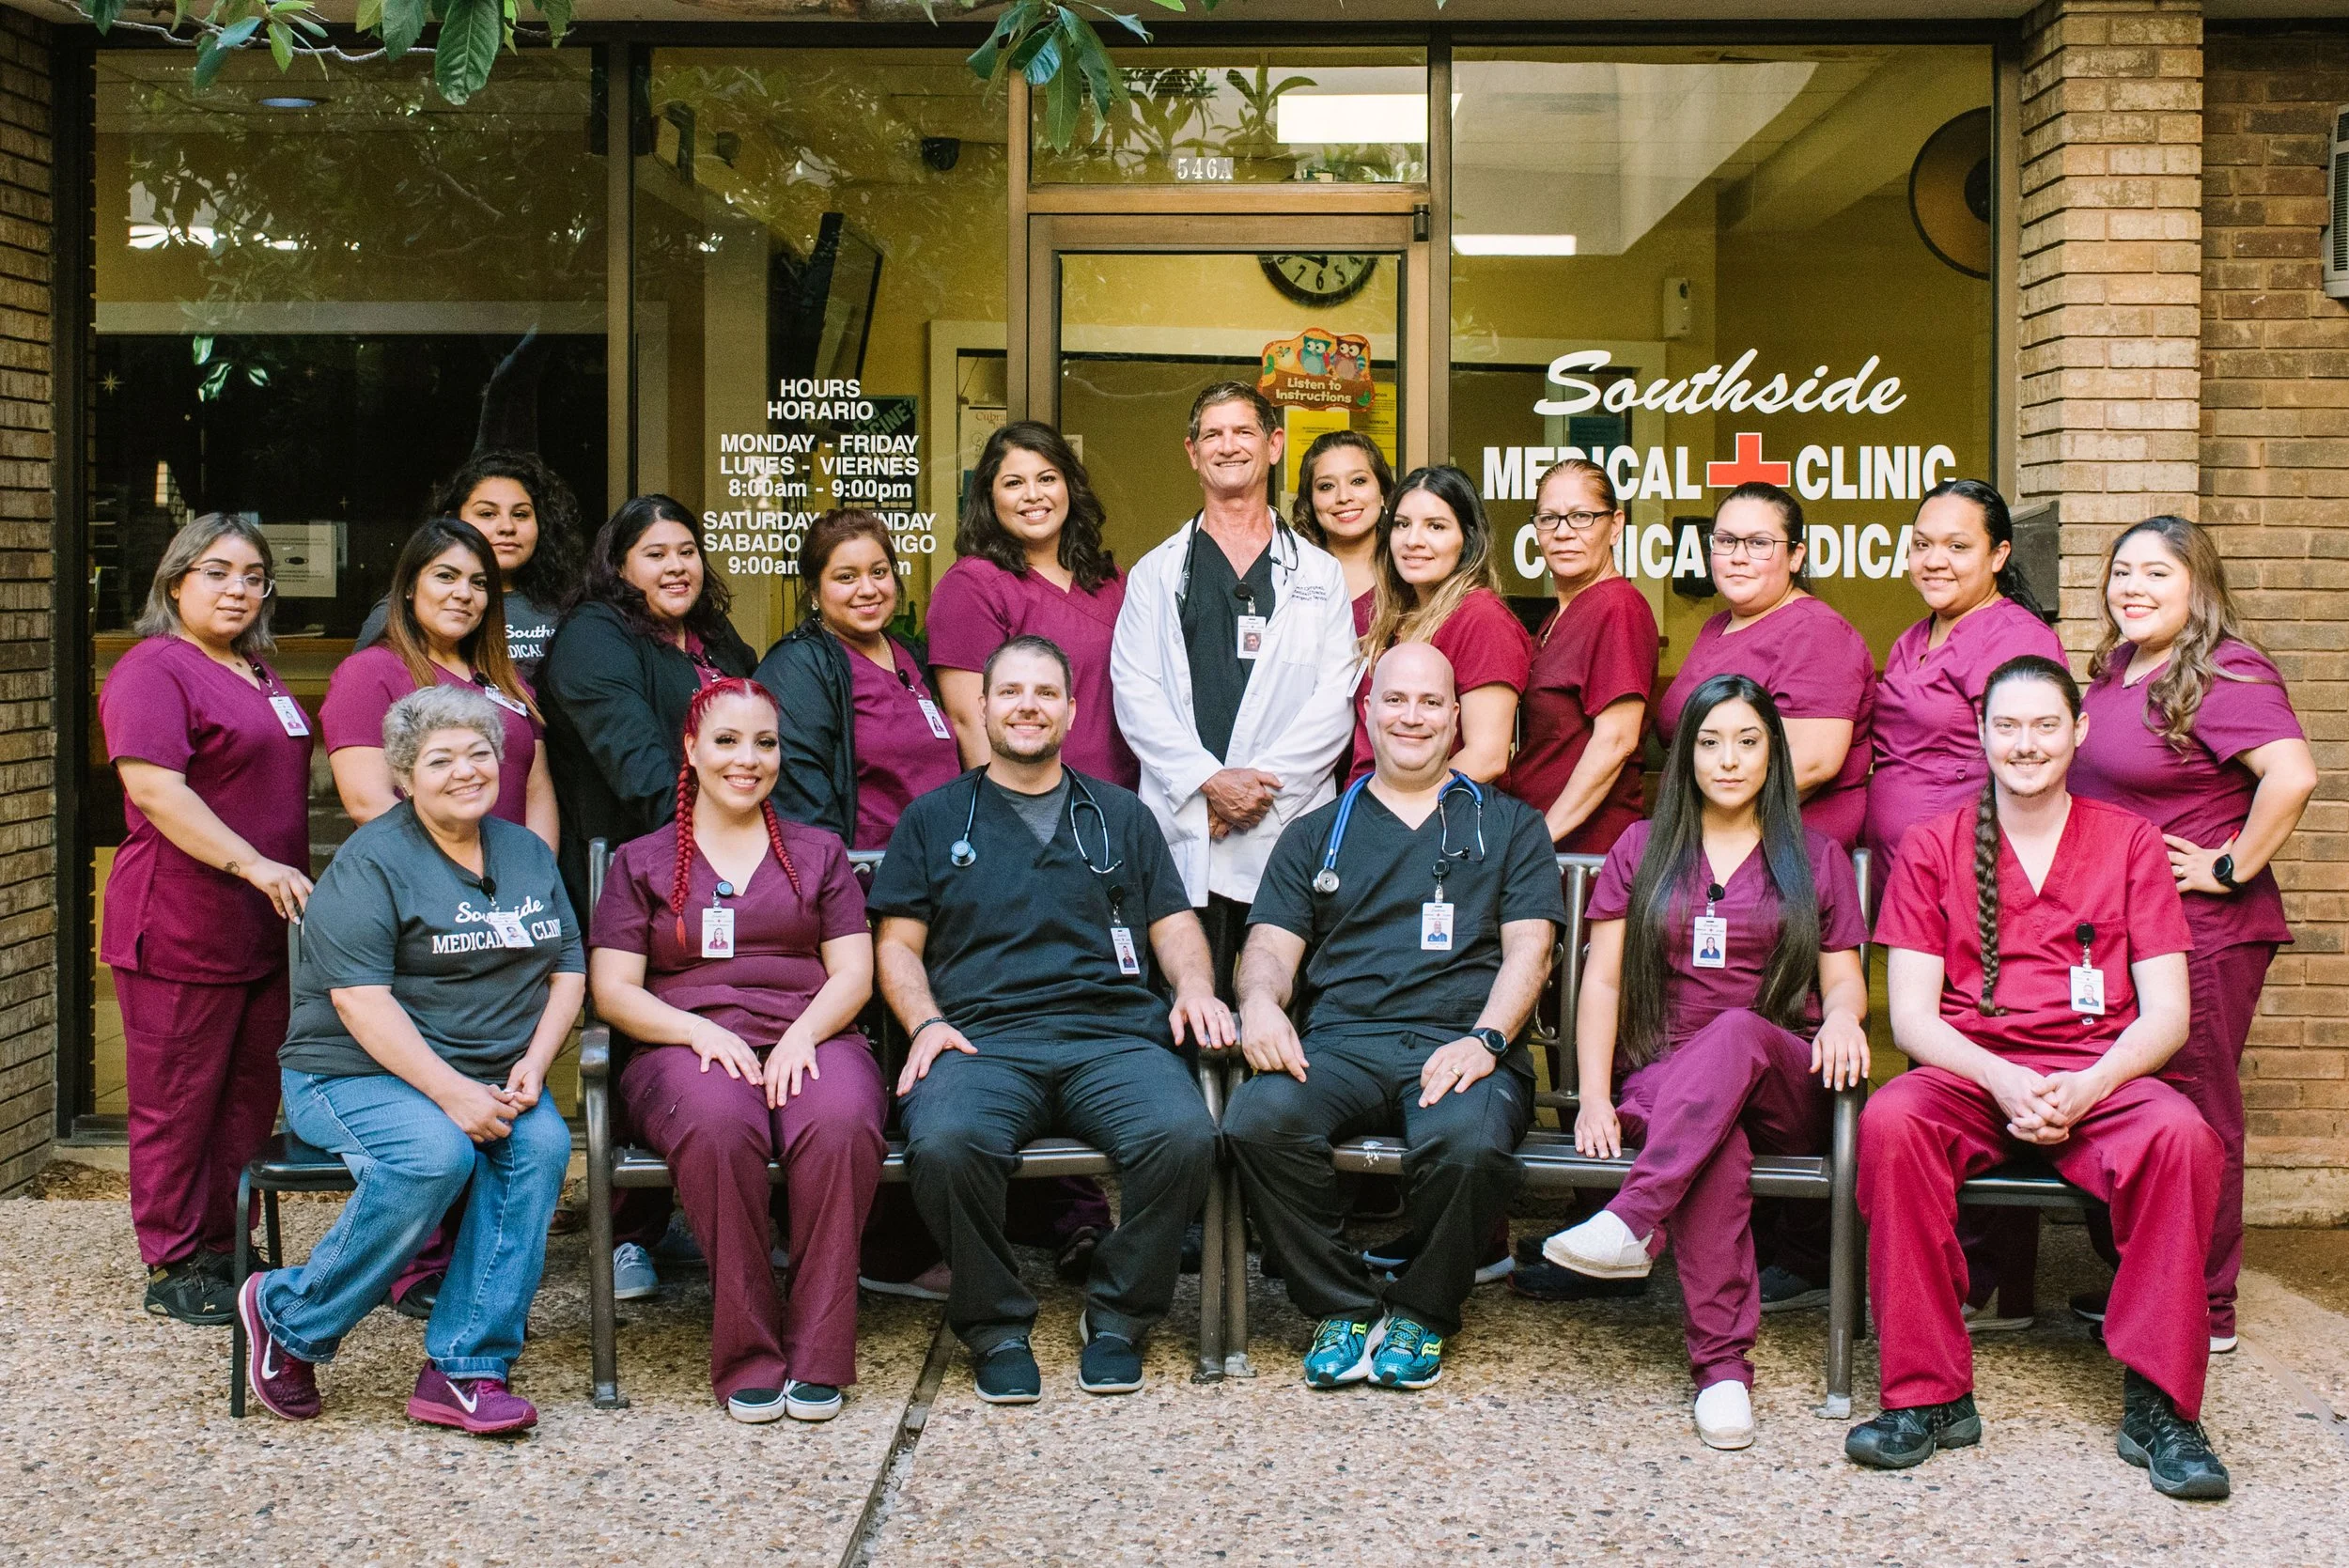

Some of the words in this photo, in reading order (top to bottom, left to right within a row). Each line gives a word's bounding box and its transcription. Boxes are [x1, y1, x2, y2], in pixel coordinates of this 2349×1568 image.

[1177, 158, 1234, 179] 546A
[780, 379, 861, 398] HOURS
[1287, 377, 1326, 390] Listen
[1329, 380, 1342, 391] to
[1532, 348, 1907, 415] Southside
[1275, 389, 1352, 403] Instructions
[767, 400, 874, 420] HORARIO
[721, 434, 816, 453] MONDAY
[839, 434, 919, 453] FRIDAY
[720, 456, 796, 475] LUNES
[820, 457, 920, 476] VIERNES
[1483, 444, 1703, 501] MECAL
[1795, 444, 1956, 501] CLINIC
[728, 479, 807, 498] 8:00am
[831, 479, 912, 502] 9:00pm
[873, 513, 937, 531] NDAY
[704, 534, 801, 553] SABADO
[507, 644, 545, 659] DICAL
[432, 930, 505, 955] MEDICAL
